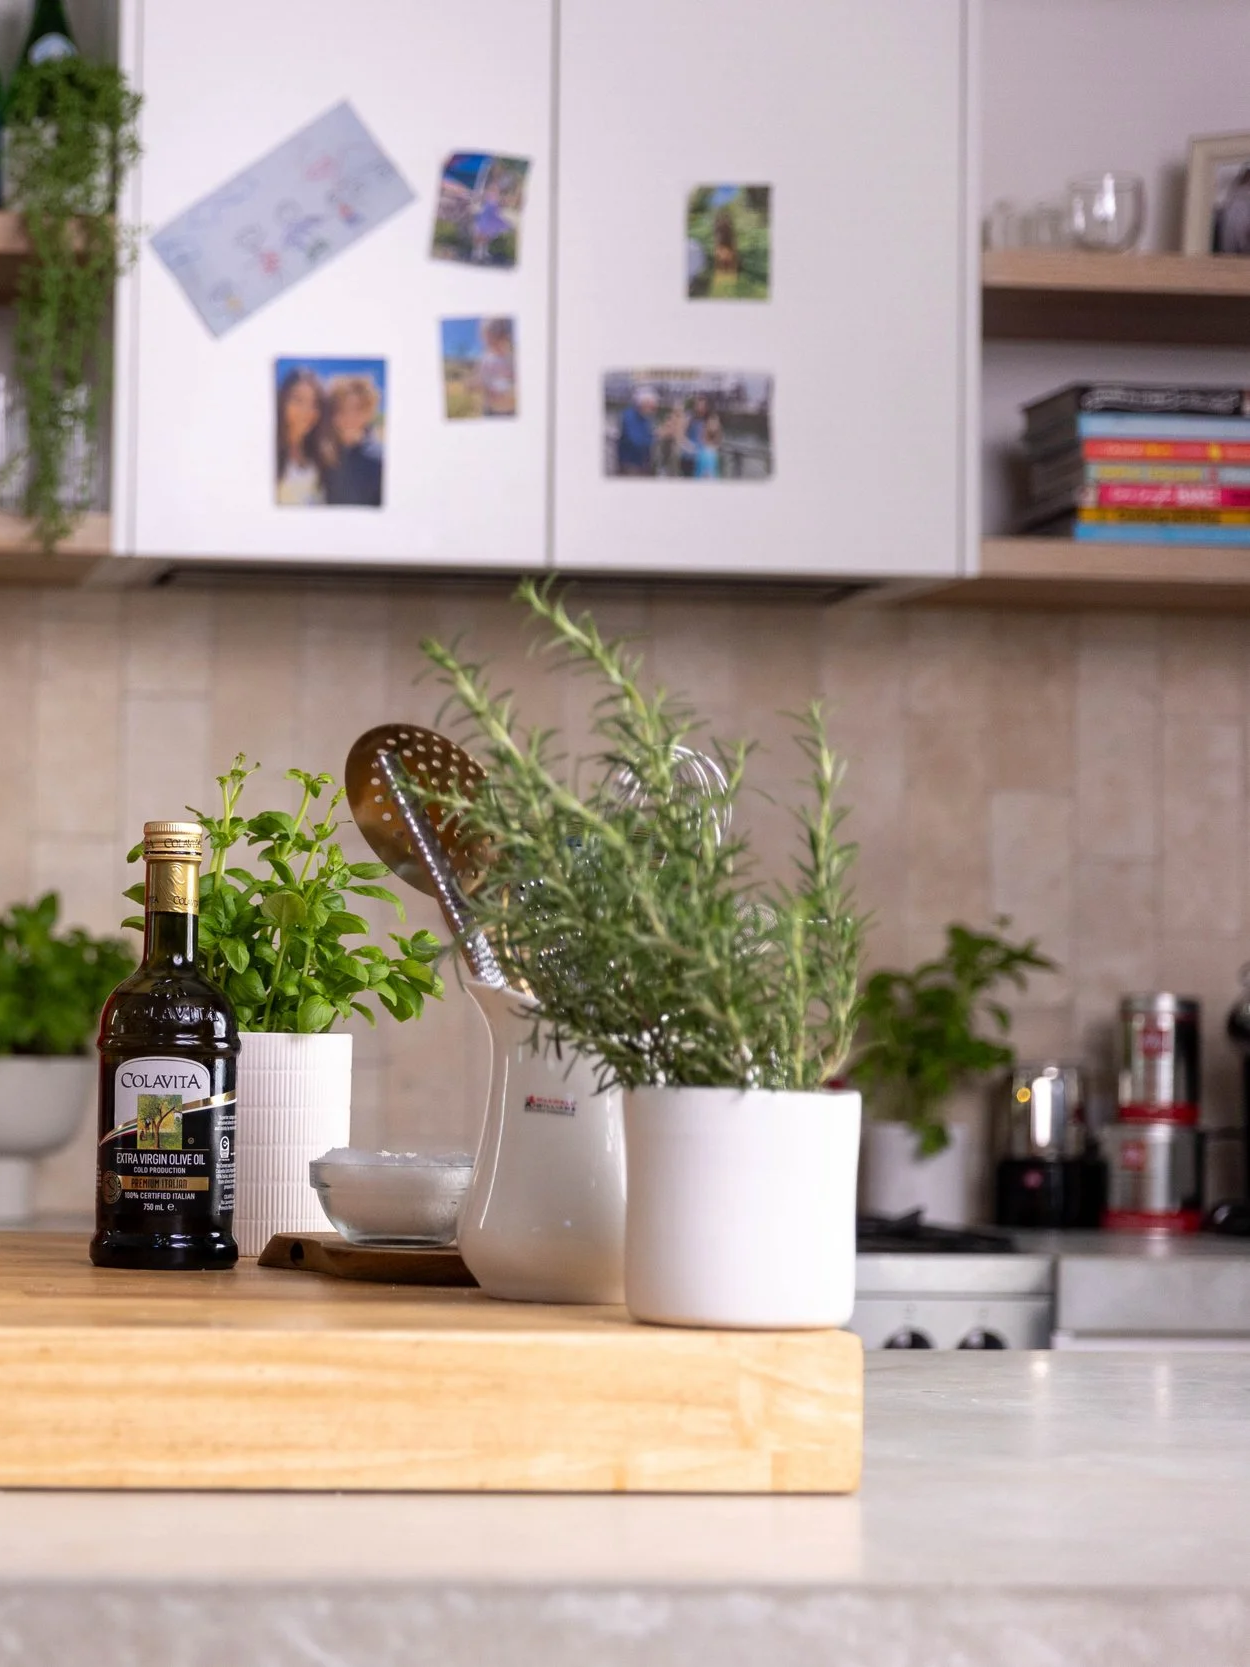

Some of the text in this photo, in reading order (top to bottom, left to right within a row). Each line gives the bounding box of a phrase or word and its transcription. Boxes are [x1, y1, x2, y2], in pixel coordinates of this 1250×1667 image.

[121, 1073, 201, 1089] COLAVITA
[116, 1153, 206, 1165] EXTRA VIRGIN OLIVE OIL
[131, 1178, 187, 1189] PREMIUM ITALIAN
[143, 1203, 153, 1211] 750
